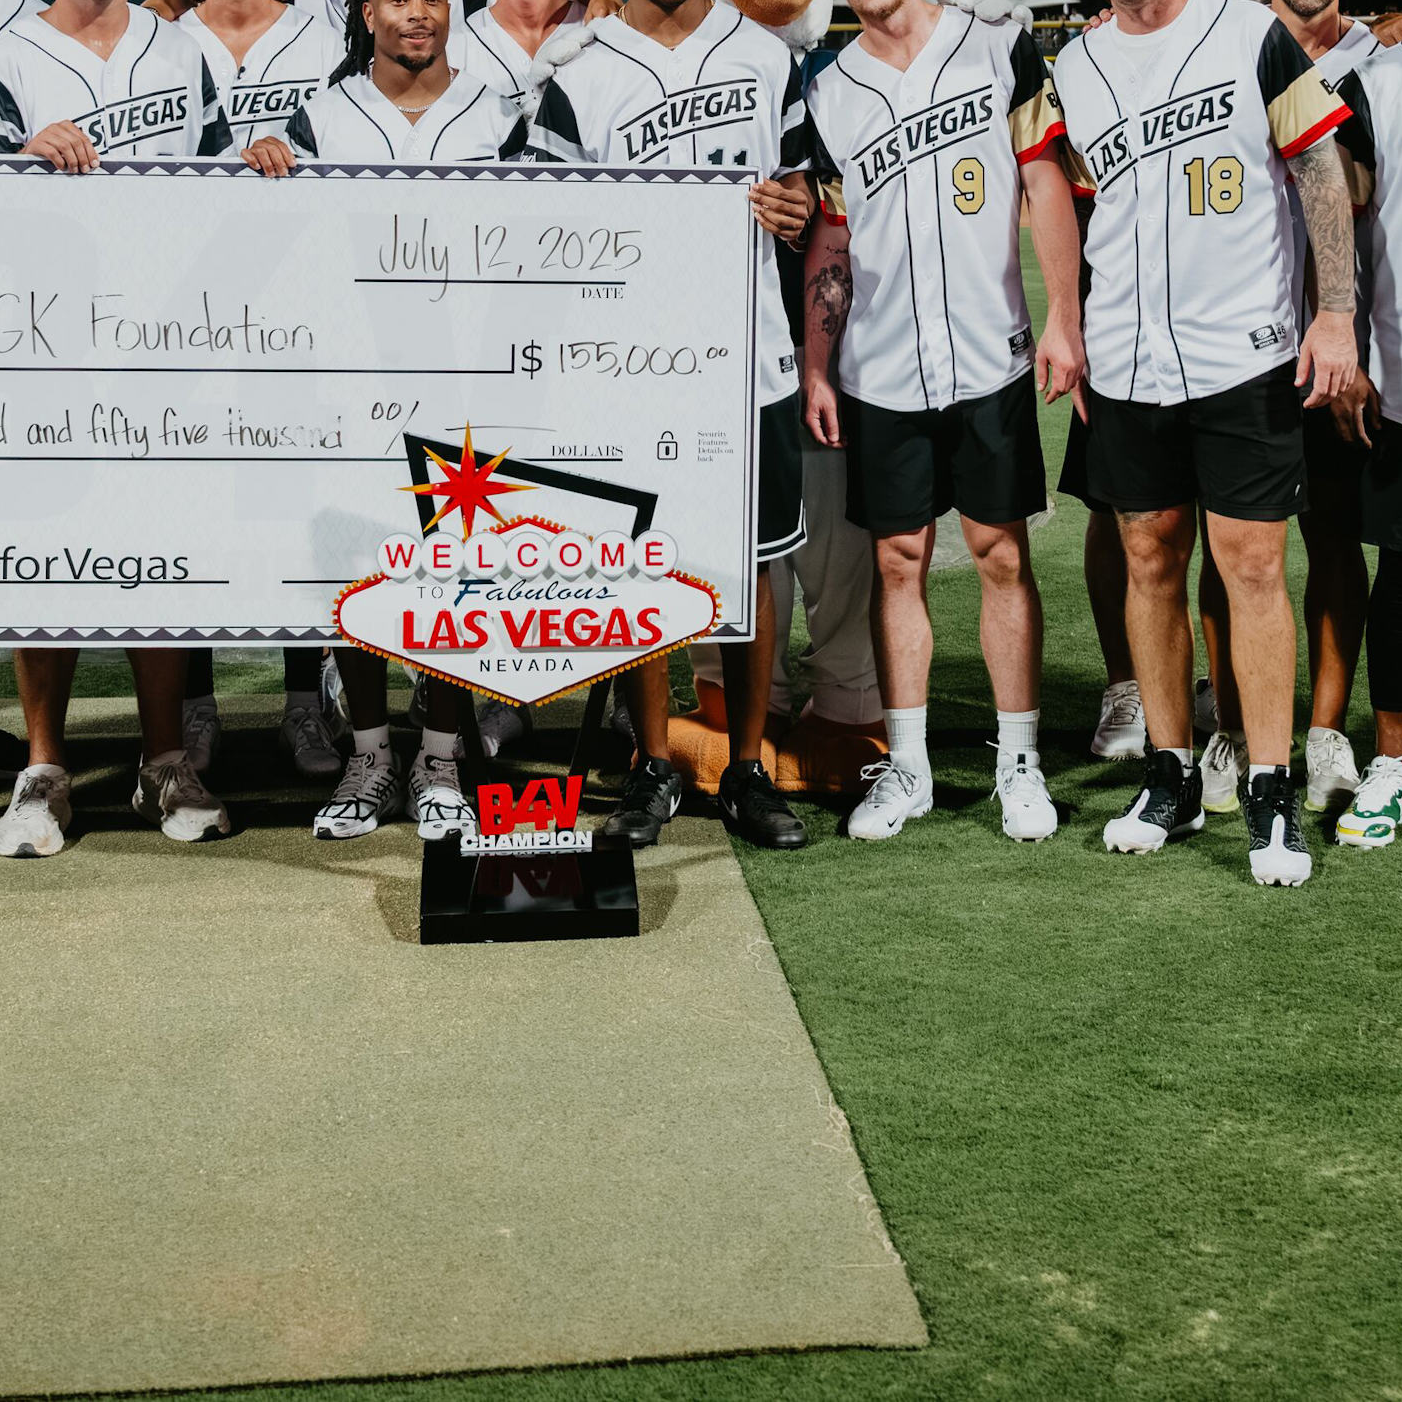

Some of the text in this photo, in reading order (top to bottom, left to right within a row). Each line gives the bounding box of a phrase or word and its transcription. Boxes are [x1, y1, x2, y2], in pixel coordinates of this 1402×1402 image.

[109, 93, 188, 137] VEGAS
[623, 86, 758, 162] LAS VEGAS
[1090, 89, 1235, 183] LAS VEGAS
[856, 93, 993, 190] LAS VEGAS
[951, 157, 986, 215] 9
[1183, 155, 1245, 217] 18
[378, 213, 643, 303] July 12, 2025
[581, 286, 624, 300] DATE
[90, 291, 314, 355] Foundation
[521, 339, 543, 380] $
[26, 409, 73, 446] and
[86, 403, 149, 460] fifty
[158, 406, 210, 447] five
[551, 444, 624, 458] DOLLARS
[697, 430, 727, 439] Security
[698, 438, 729, 447] Features
[0, 545, 59, 581] for
[63, 546, 190, 591] Vegas
[384, 540, 665, 570] WELCOME
[416, 578, 619, 607] TO Fabulous
[402, 605, 664, 650] LAS VEGAS
[479, 658, 576, 673] NEVADA
[476, 774, 584, 836] B4V
[459, 830, 593, 851] CHAMPION
